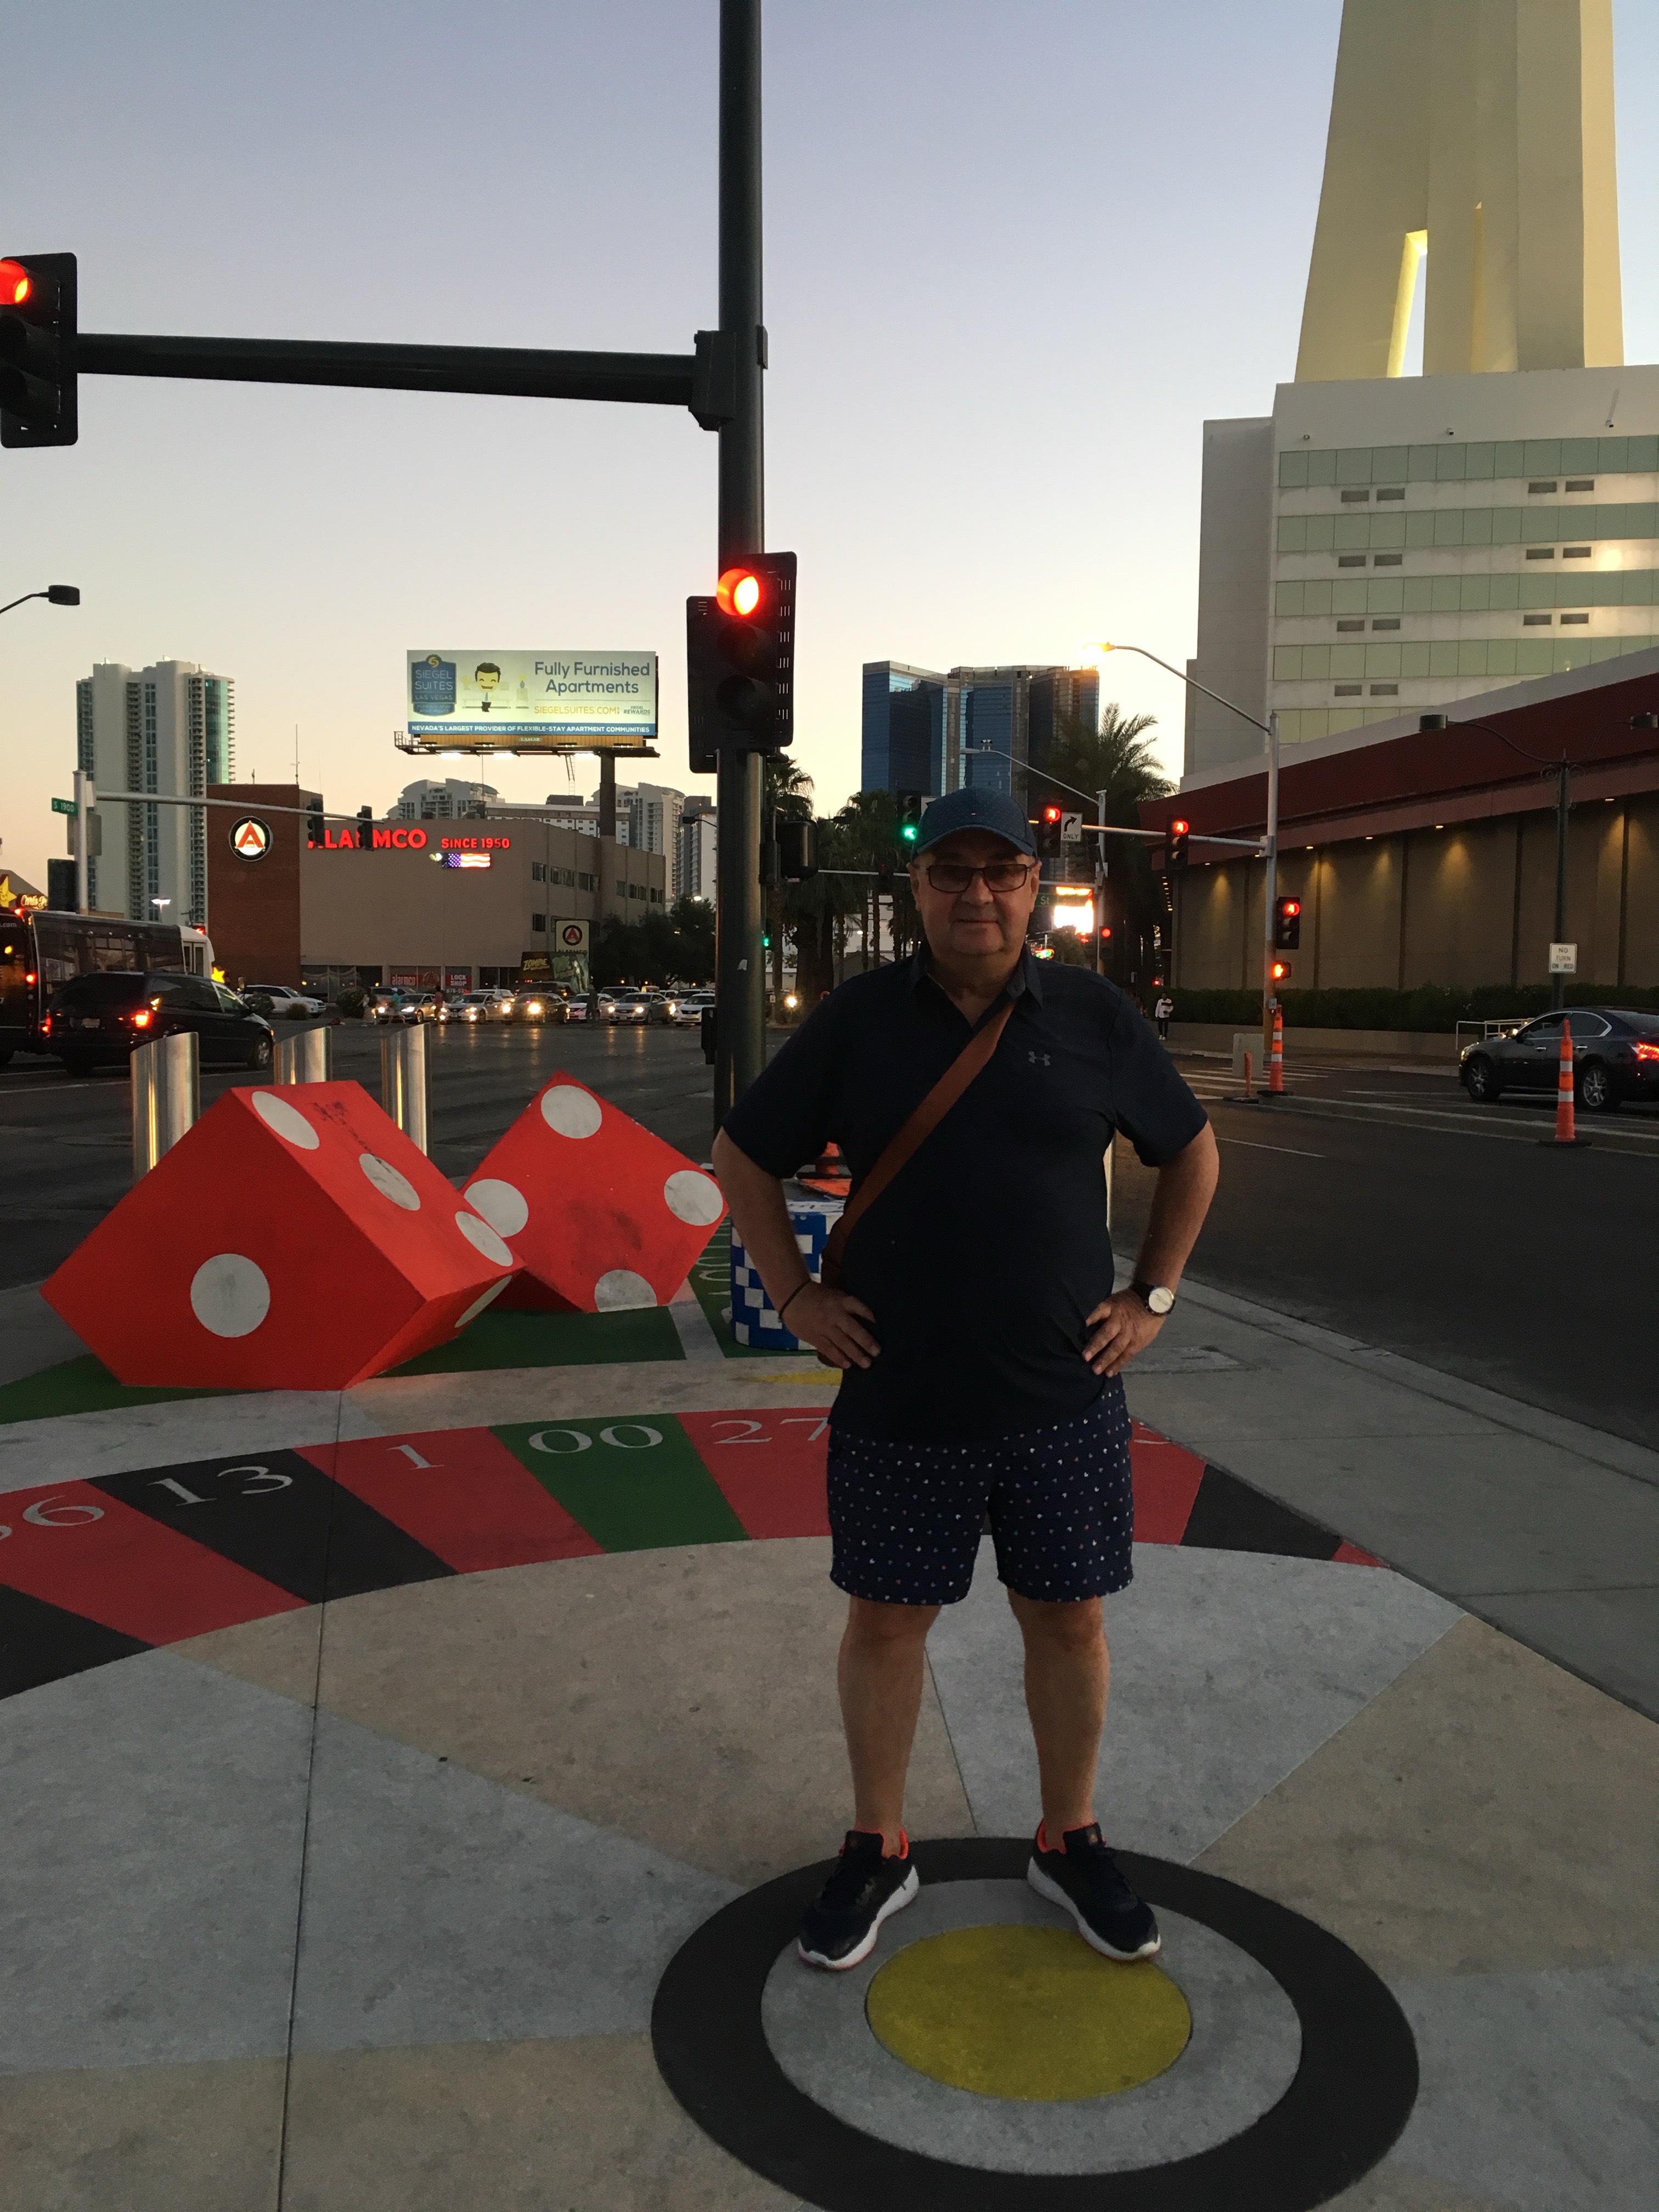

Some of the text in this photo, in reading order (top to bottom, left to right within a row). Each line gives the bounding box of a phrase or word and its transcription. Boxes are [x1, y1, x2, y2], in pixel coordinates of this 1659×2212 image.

[415, 670, 452, 679] SIEGEL
[535, 662, 650, 679] Fully Furnished
[415, 681, 453, 690] SUITES
[545, 679, 639, 696] Apartments
[534, 706, 616, 714] SIEGELSUITES.COM
[441, 837, 510, 849] SINCE 1950
[1040, 896, 1049, 905] St
[392, 974, 416, 986] alarmco
[710, 1416, 831, 1444] 27
[528, 1424, 663, 1454] 00
[387, 1443, 445, 1470] 1
[146, 1465, 294, 1506] 13
